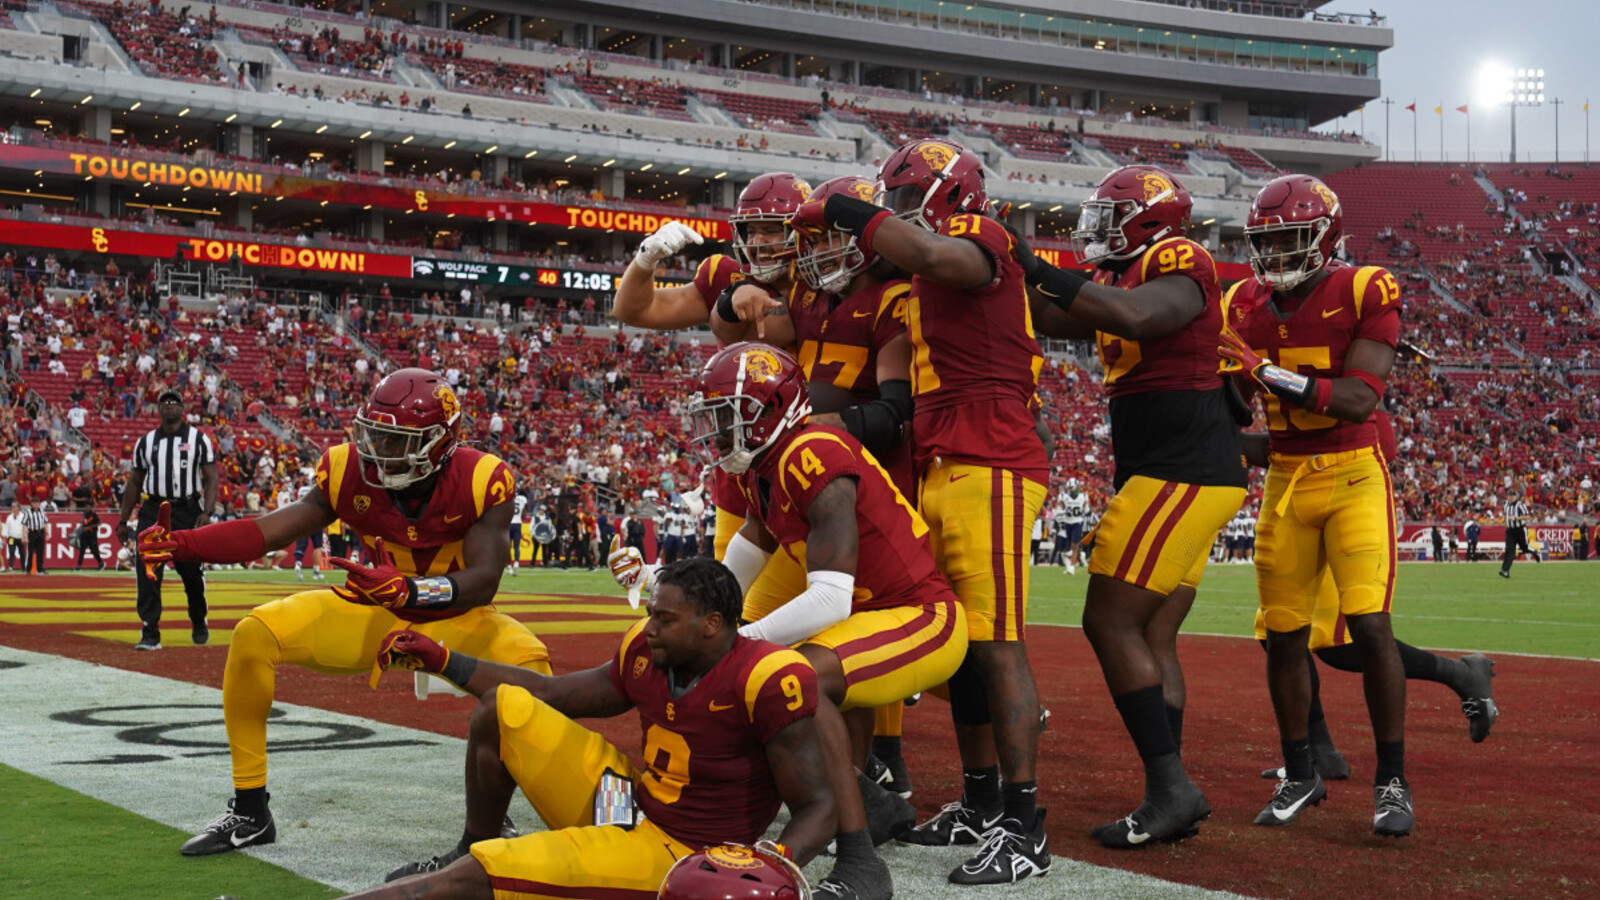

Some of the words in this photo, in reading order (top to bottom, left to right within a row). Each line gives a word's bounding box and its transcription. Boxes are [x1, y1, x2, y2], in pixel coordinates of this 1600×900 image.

[69, 153, 262, 194] TOUCHDOWN!
[91, 228, 109, 253] SC
[948, 215, 981, 237] 51
[1158, 244, 1195, 274] 92
[437, 262, 463, 272] WOLF
[464, 264, 488, 274] PACK
[498, 266, 509, 283] 7
[539, 271, 557, 285] 40
[563, 271, 612, 291] 12:05
[1374, 272, 1400, 306] 15
[1278, 324, 1289, 340] SC
[787, 447, 826, 491] 14
[490, 468, 516, 507] 34
[407, 526, 418, 541] SC
[780, 674, 804, 712] 9
[666, 702, 676, 721] SC
[641, 723, 691, 805] 9
